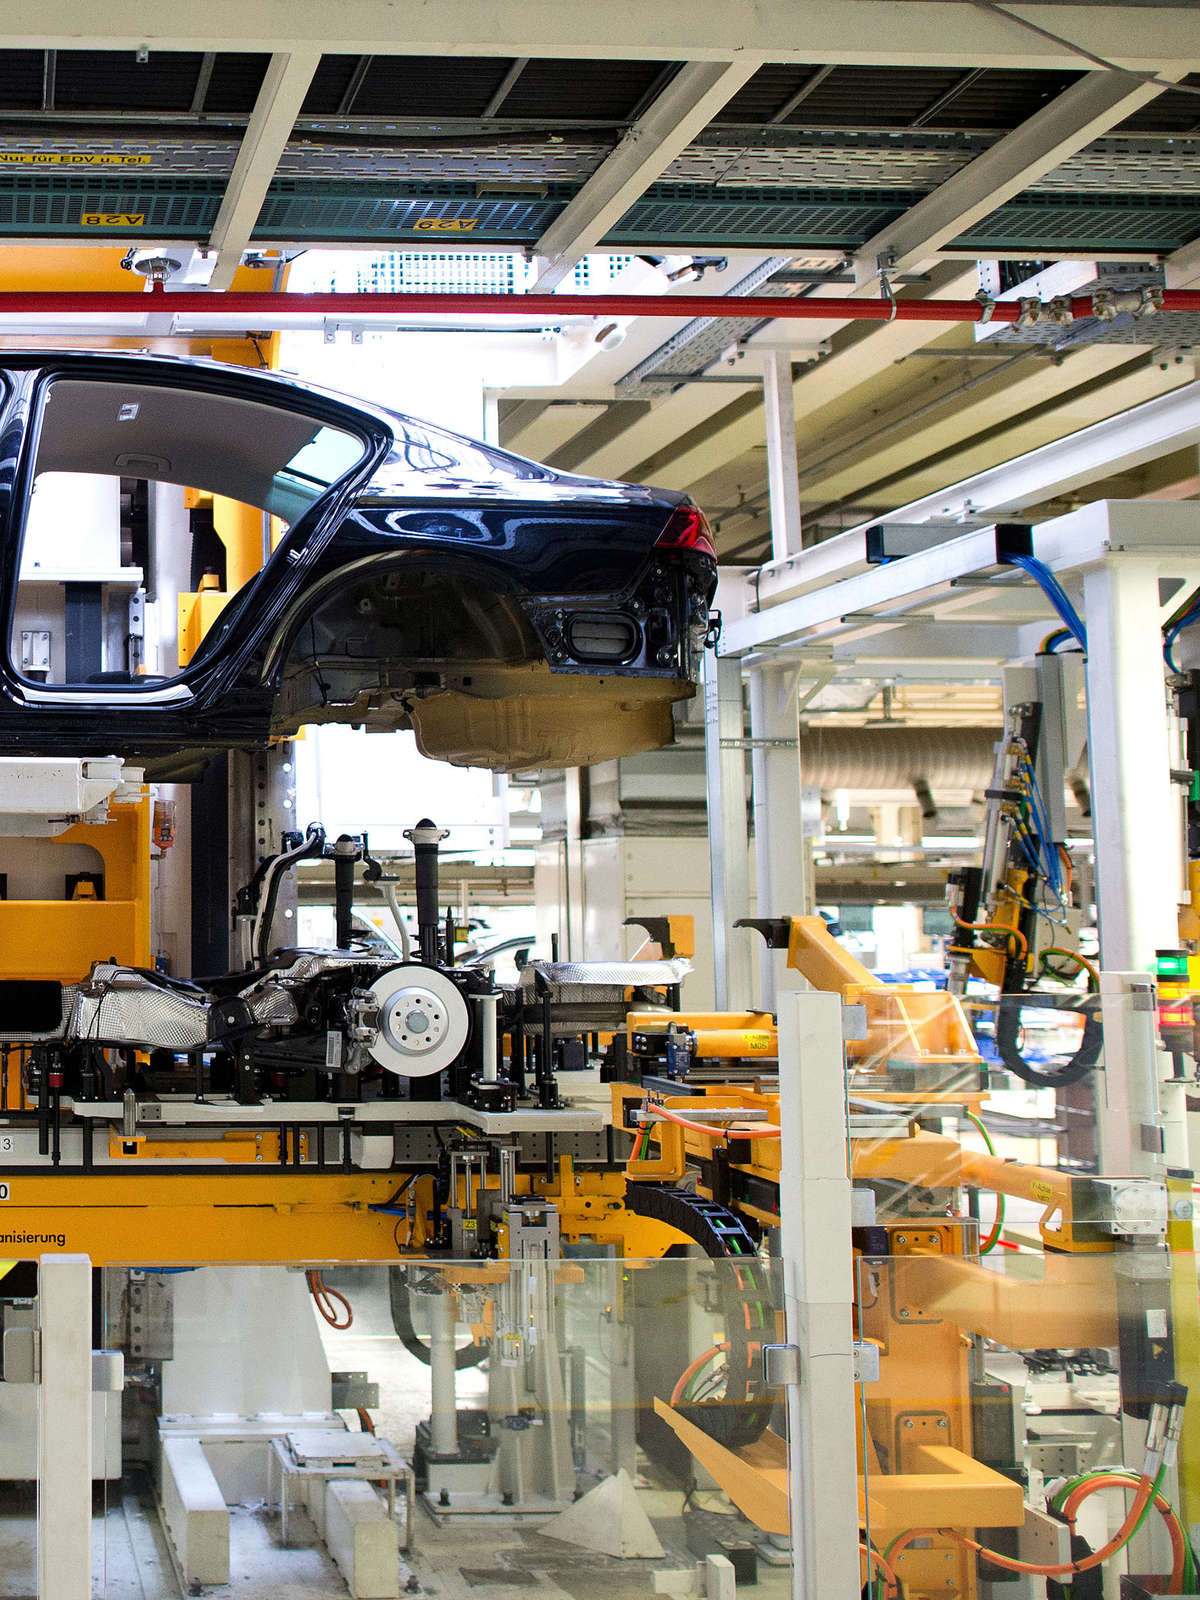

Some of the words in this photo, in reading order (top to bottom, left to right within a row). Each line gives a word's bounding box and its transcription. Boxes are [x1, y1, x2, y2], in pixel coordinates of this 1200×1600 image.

[31, 154, 56, 163] für
[60, 155, 95, 163] EDV
[119, 155, 146, 164] Tel.
[86, 215, 143, 225] A28
[418, 220, 476, 229] A29
